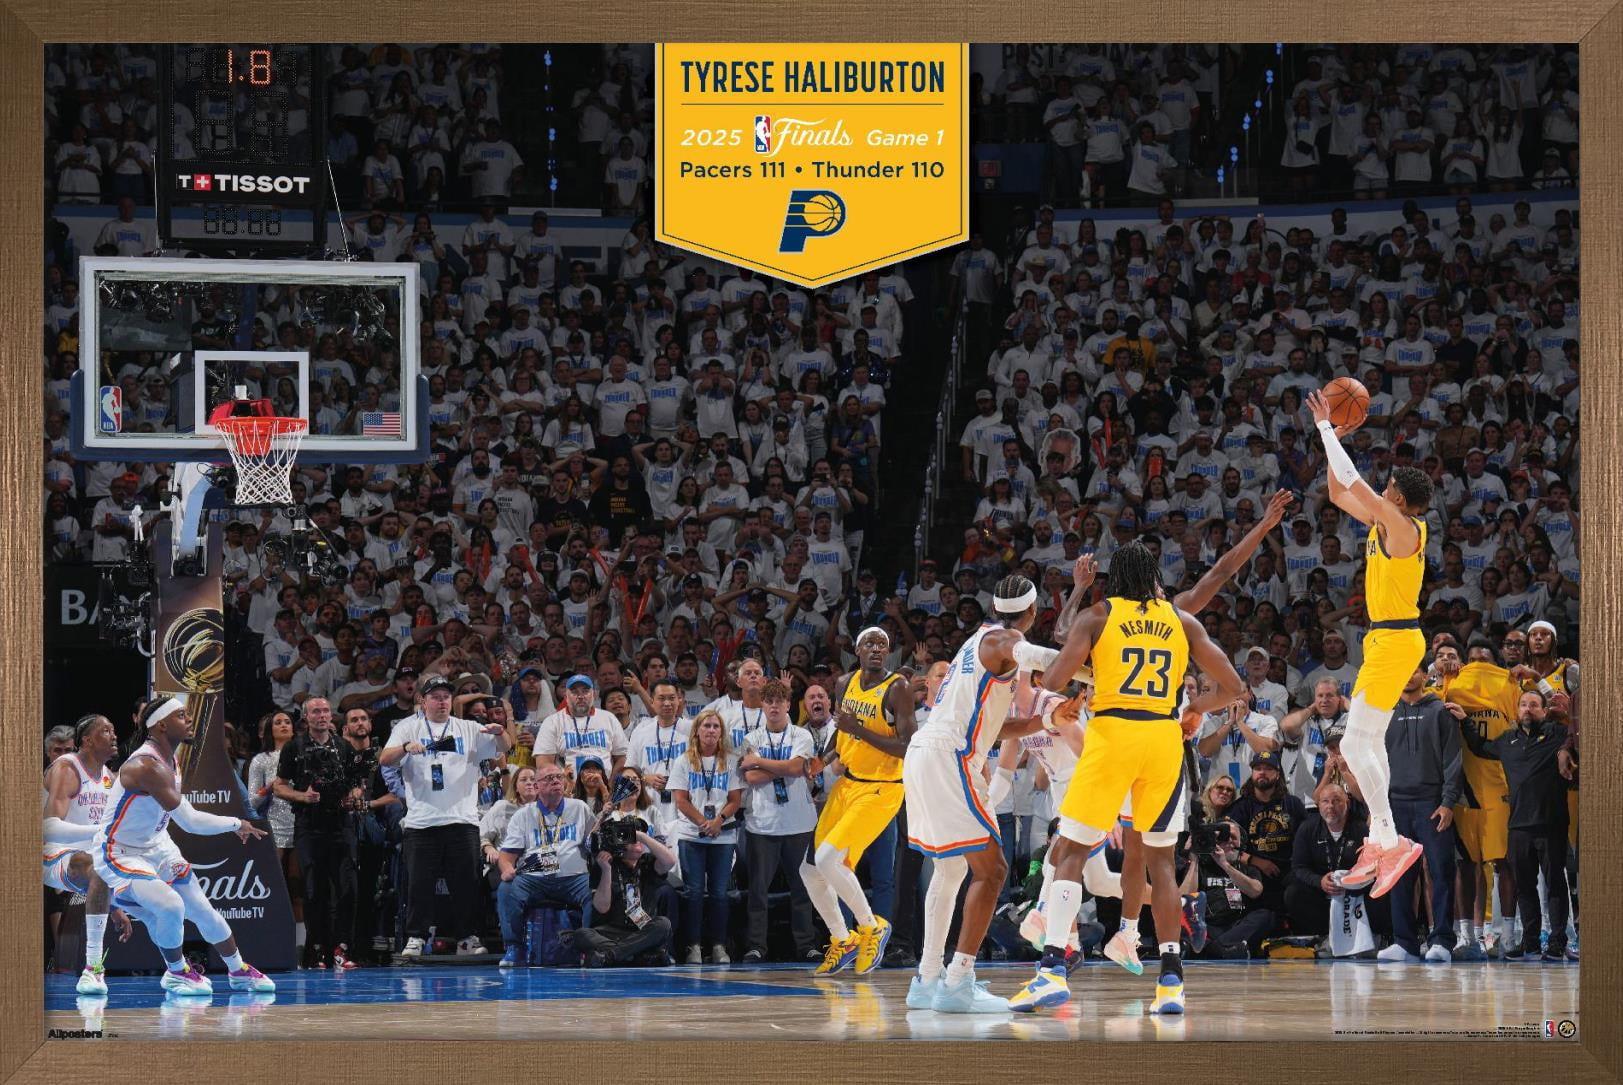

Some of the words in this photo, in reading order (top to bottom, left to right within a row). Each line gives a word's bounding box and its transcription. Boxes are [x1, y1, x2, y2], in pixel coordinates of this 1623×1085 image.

[227, 49, 271, 85] 1.8
[214, 174, 311, 194] TISSOT
[1120, 620, 1173, 641] NESMITH
[1119, 647, 1173, 698] 23
[217, 789, 231, 804] TV
[252, 906, 265, 919] TV
